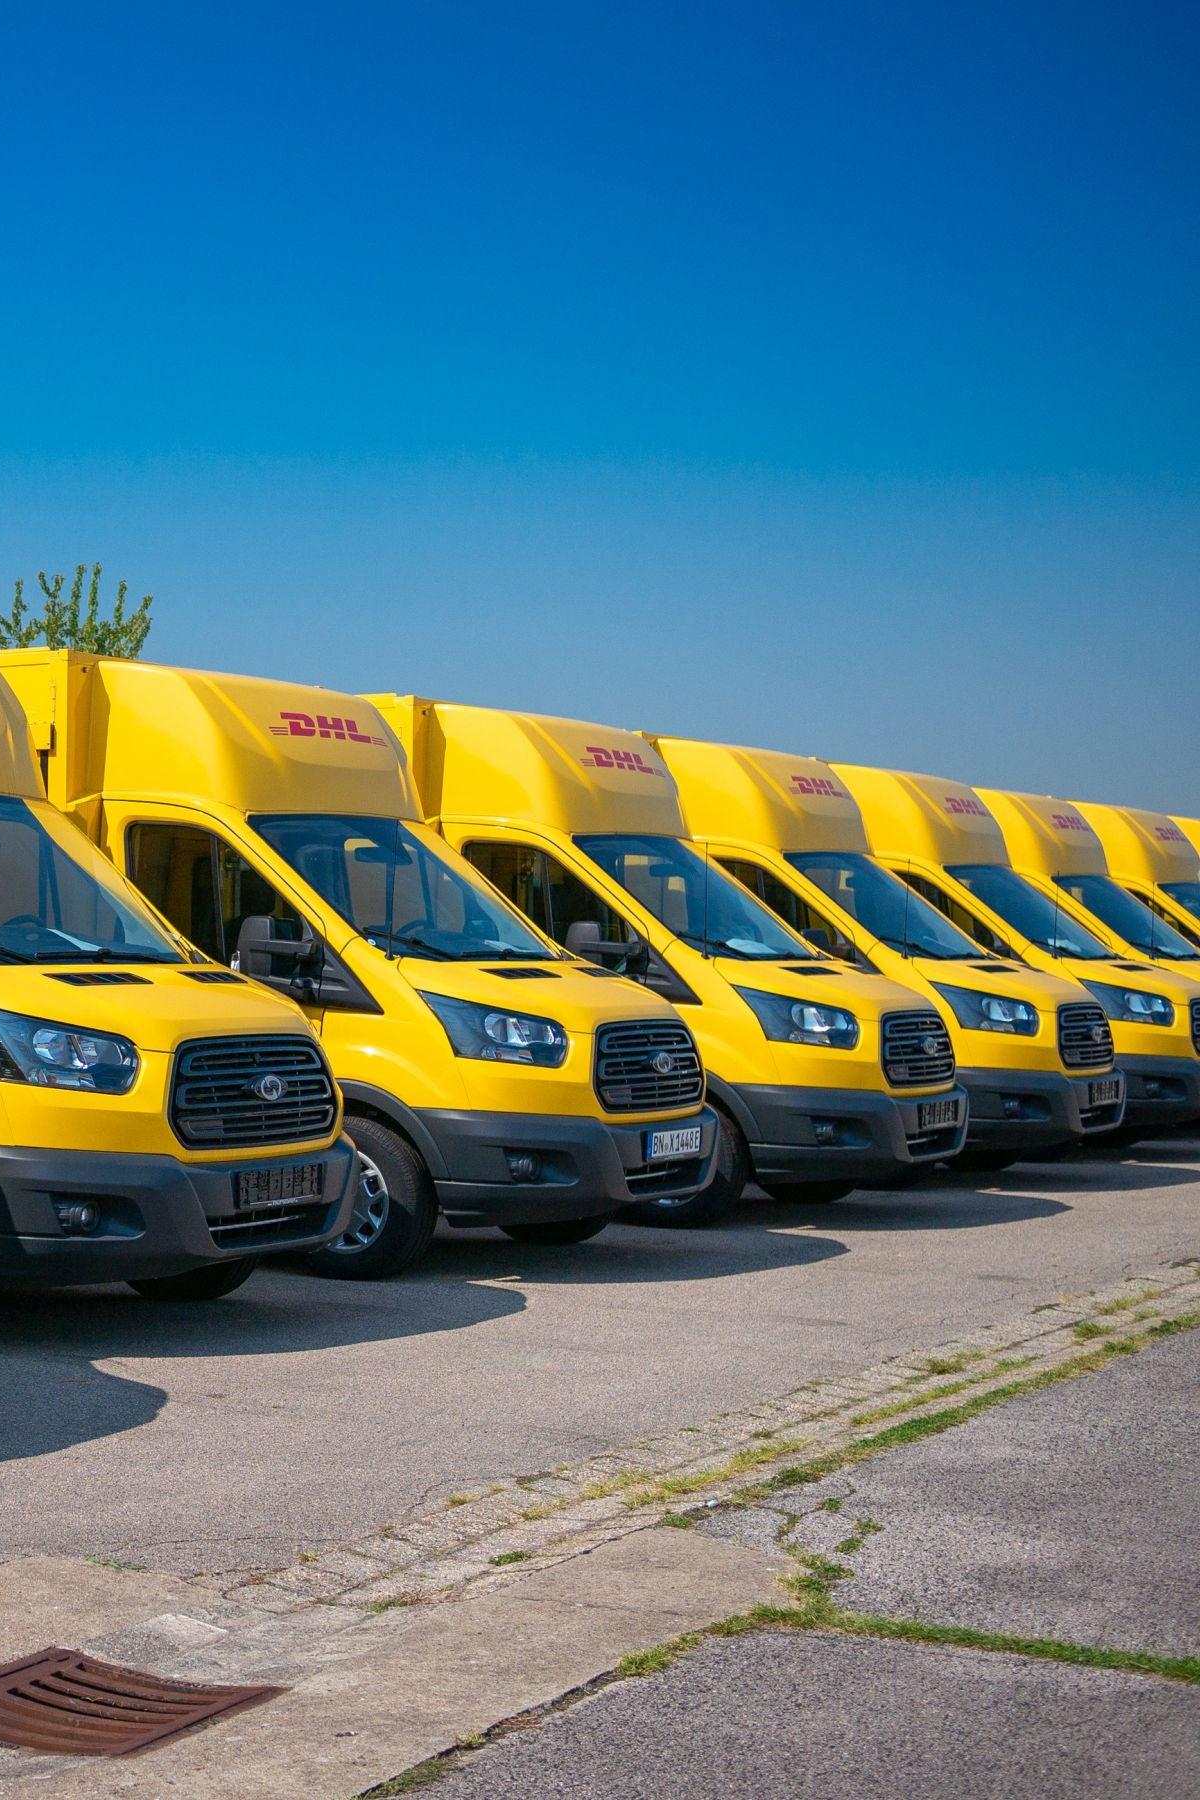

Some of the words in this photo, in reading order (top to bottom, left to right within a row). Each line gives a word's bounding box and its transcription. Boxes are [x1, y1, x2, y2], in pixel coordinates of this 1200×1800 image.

[280, 712, 372, 743] DHL
[585, 746, 655, 774] DHL
[791, 776, 843, 797] DHL
[945, 797, 987, 816] DHL
[653, 1135, 665, 1154] BN
